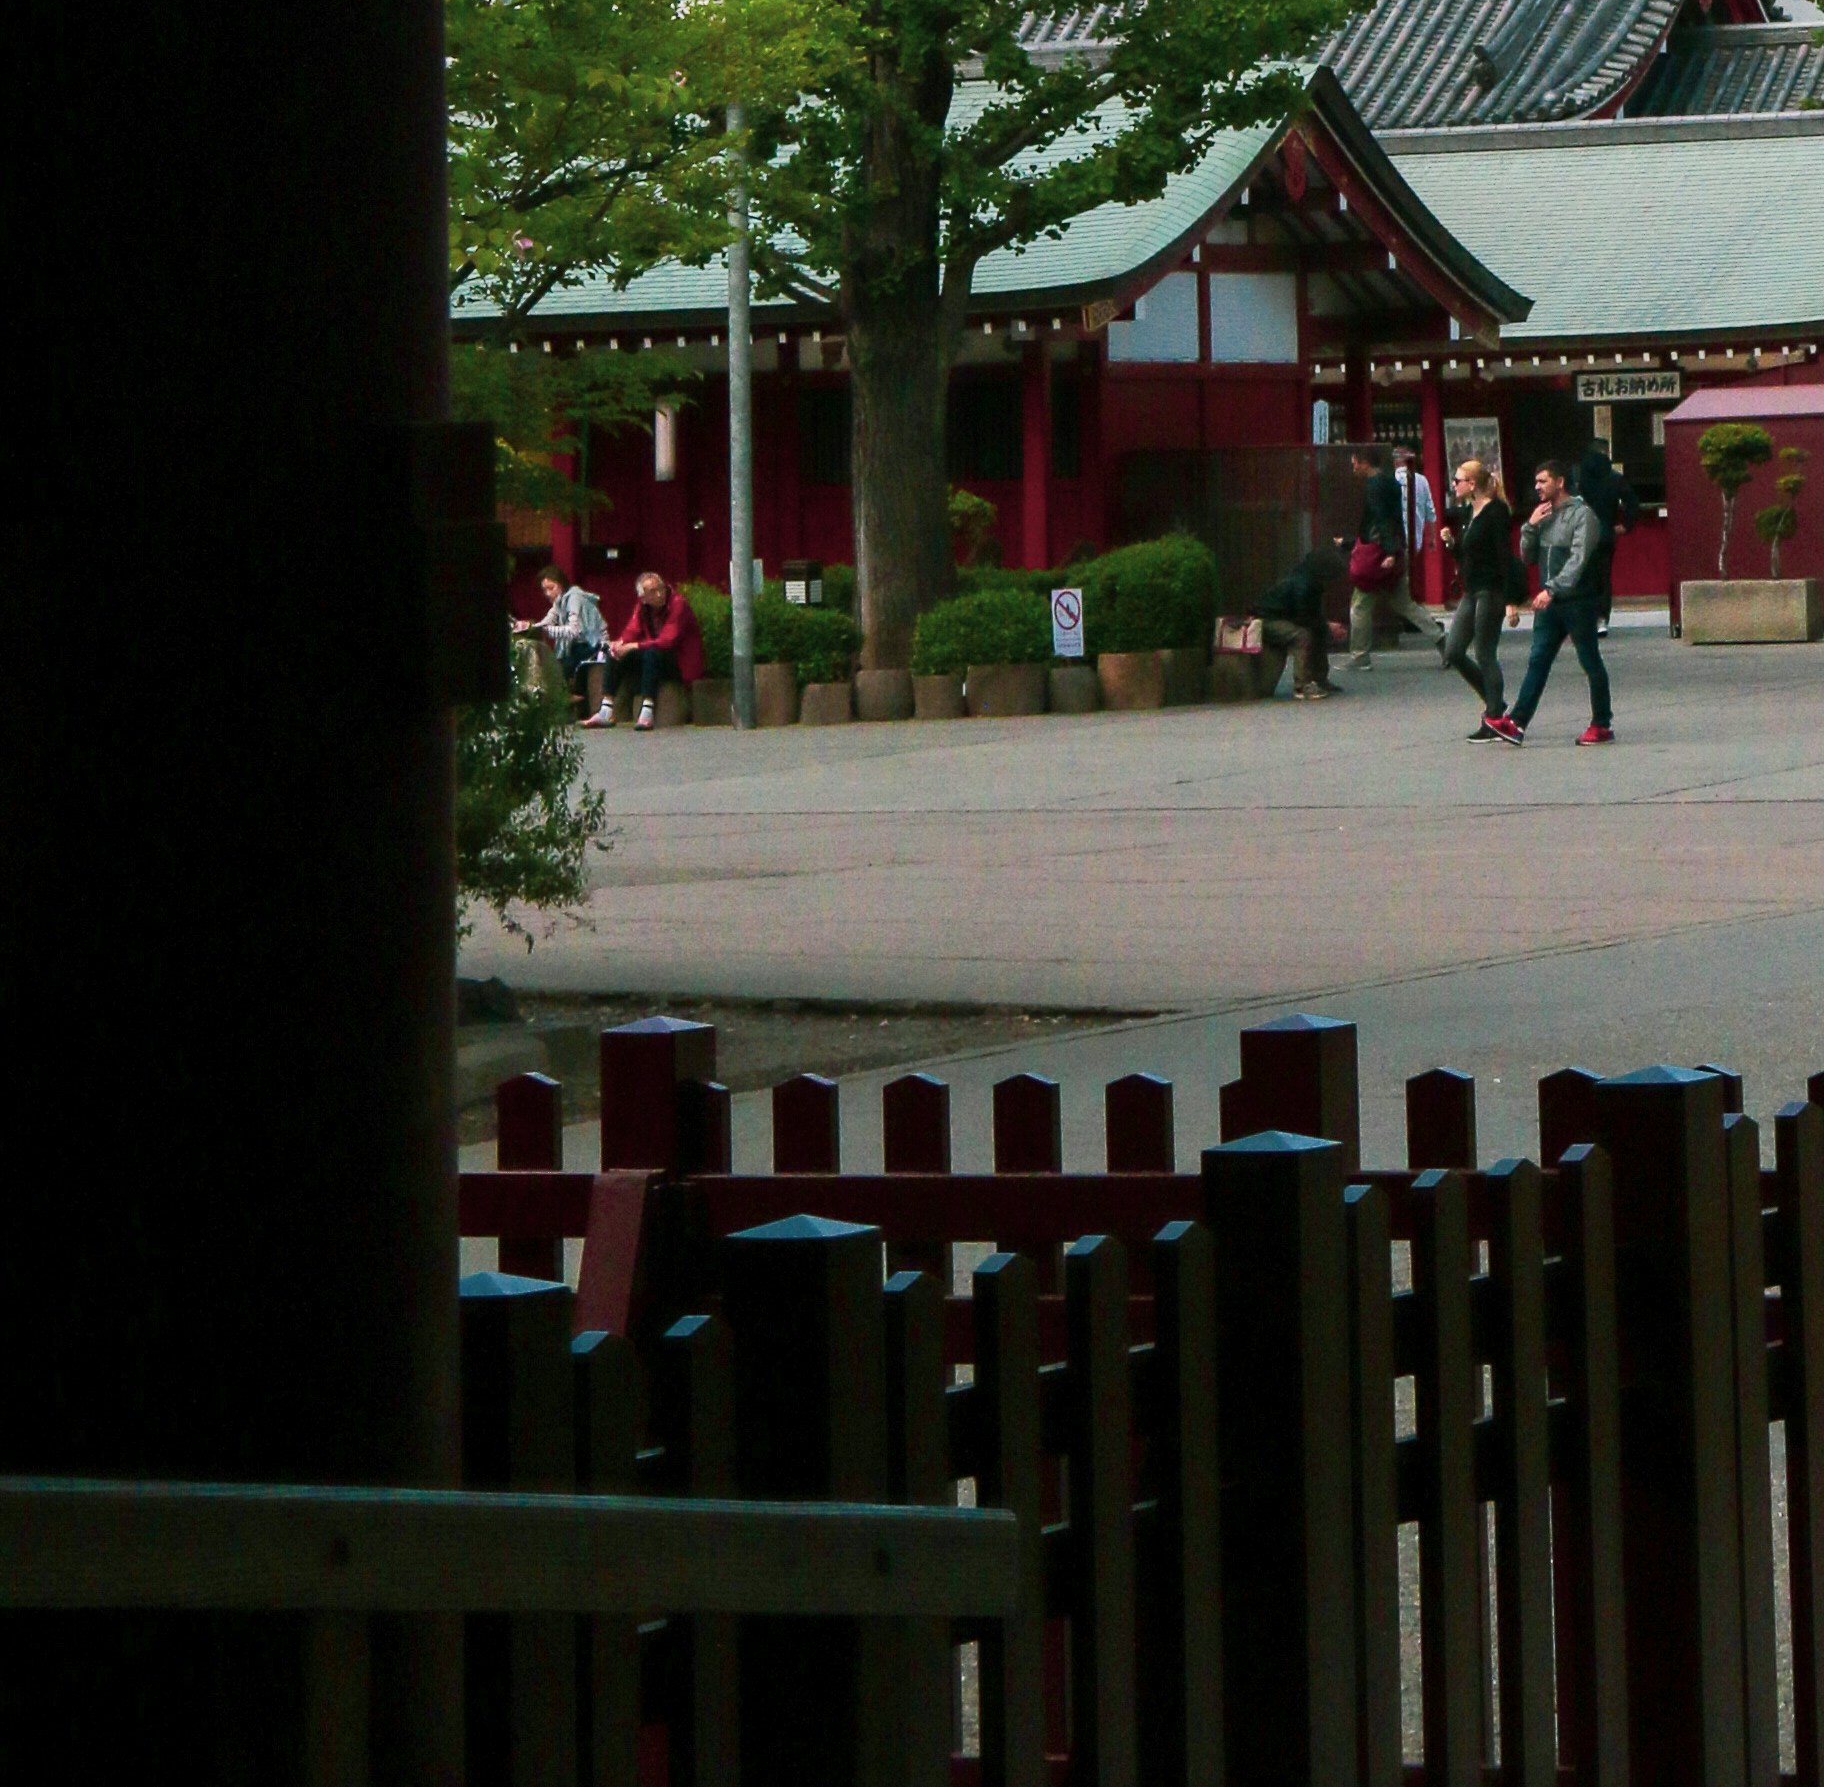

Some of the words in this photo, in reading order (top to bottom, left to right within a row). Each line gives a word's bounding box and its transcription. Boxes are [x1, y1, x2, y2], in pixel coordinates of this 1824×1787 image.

[1581, 375, 1678, 398] 古札お納め所
